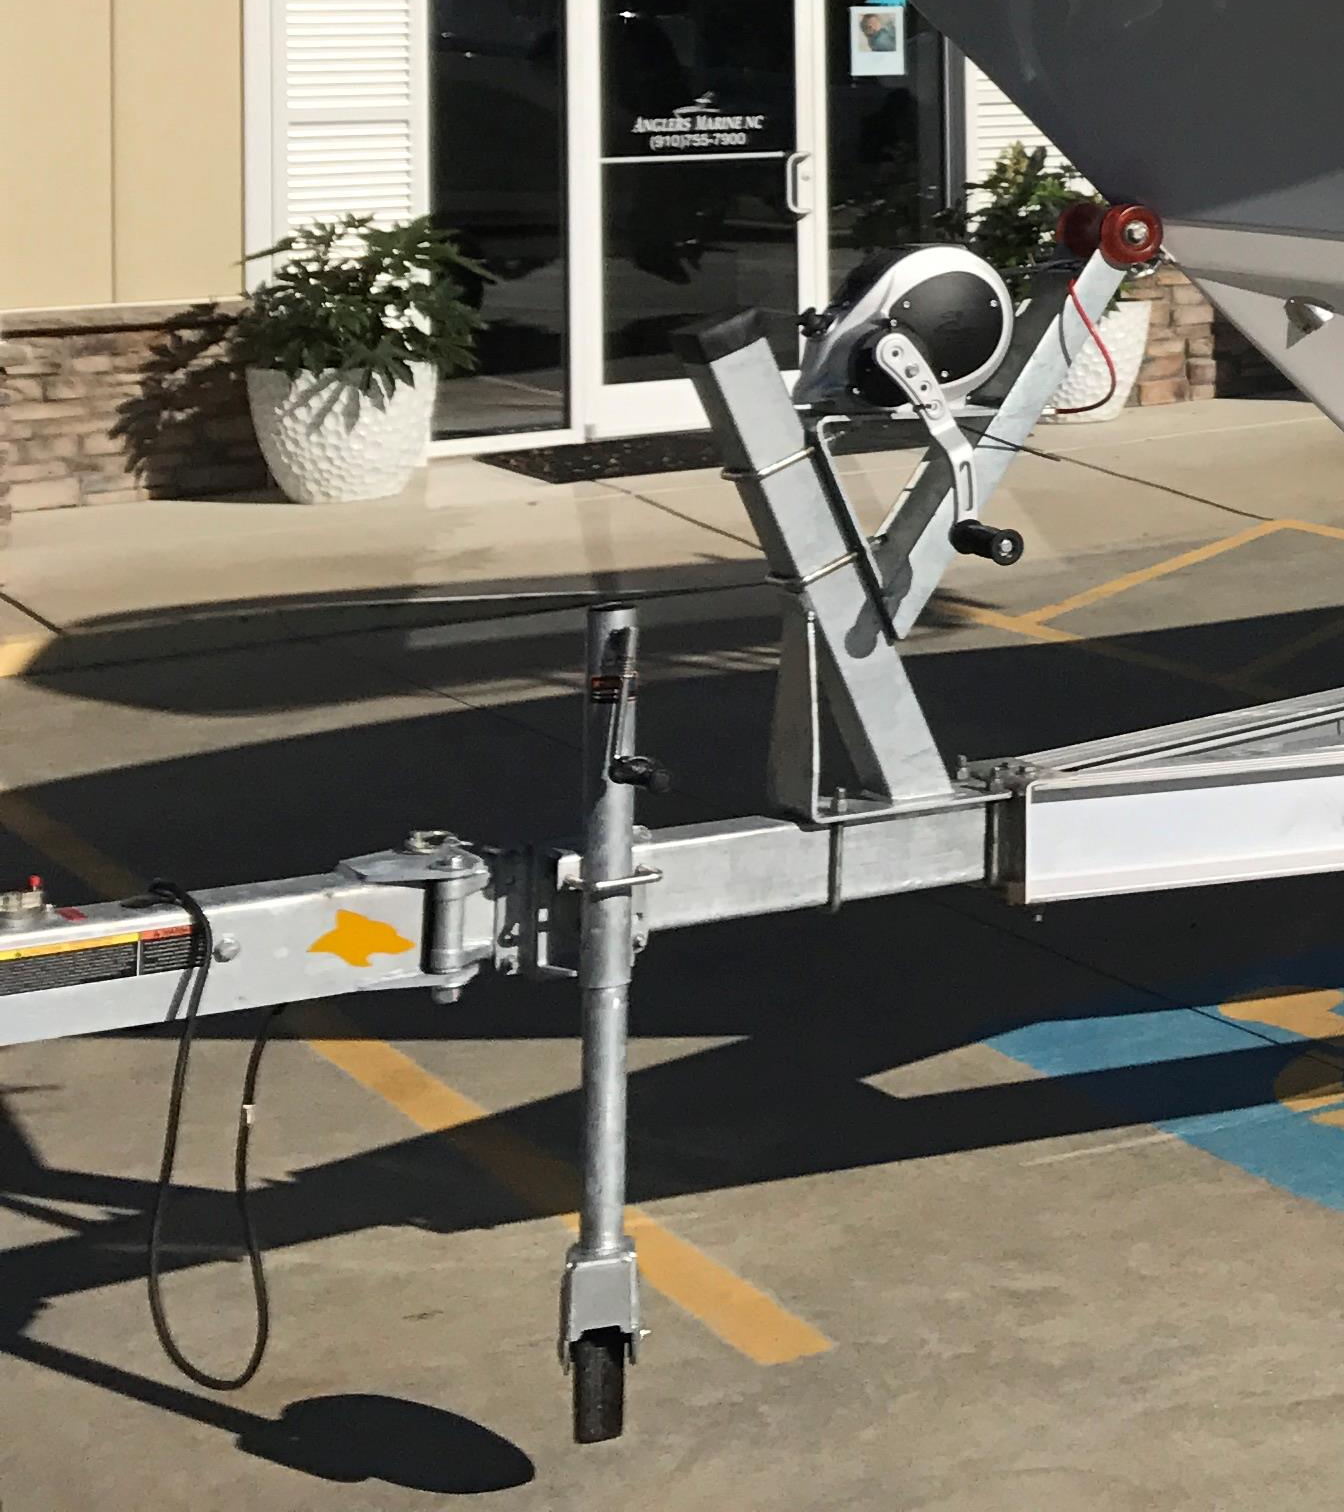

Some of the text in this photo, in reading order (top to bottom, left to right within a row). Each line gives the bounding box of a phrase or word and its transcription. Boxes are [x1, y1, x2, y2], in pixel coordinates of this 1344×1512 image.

[630, 114, 765, 133] ANGLERS MARINE NC
